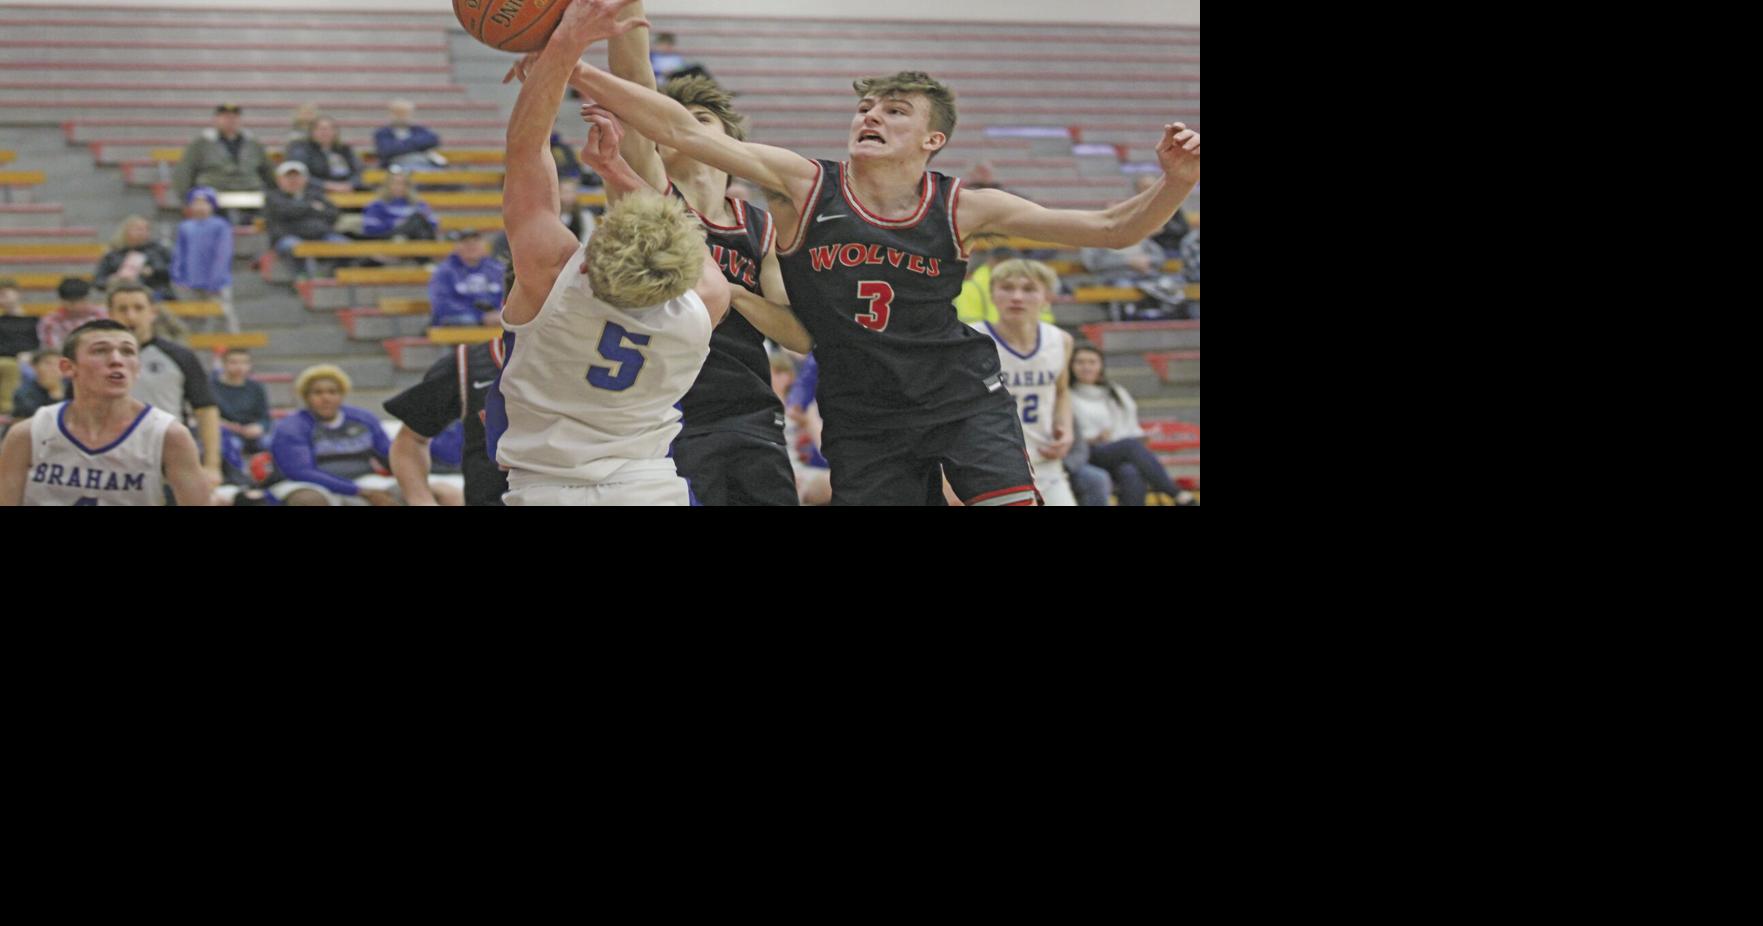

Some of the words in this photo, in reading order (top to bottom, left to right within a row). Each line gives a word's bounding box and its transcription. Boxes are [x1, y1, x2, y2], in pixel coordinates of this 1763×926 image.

[809, 243, 942, 277] WOLVES
[855, 280, 895, 333] 3
[585, 320, 652, 392] 5
[1013, 394, 1039, 423] 2
[32, 462, 145, 491] BRAHAM
